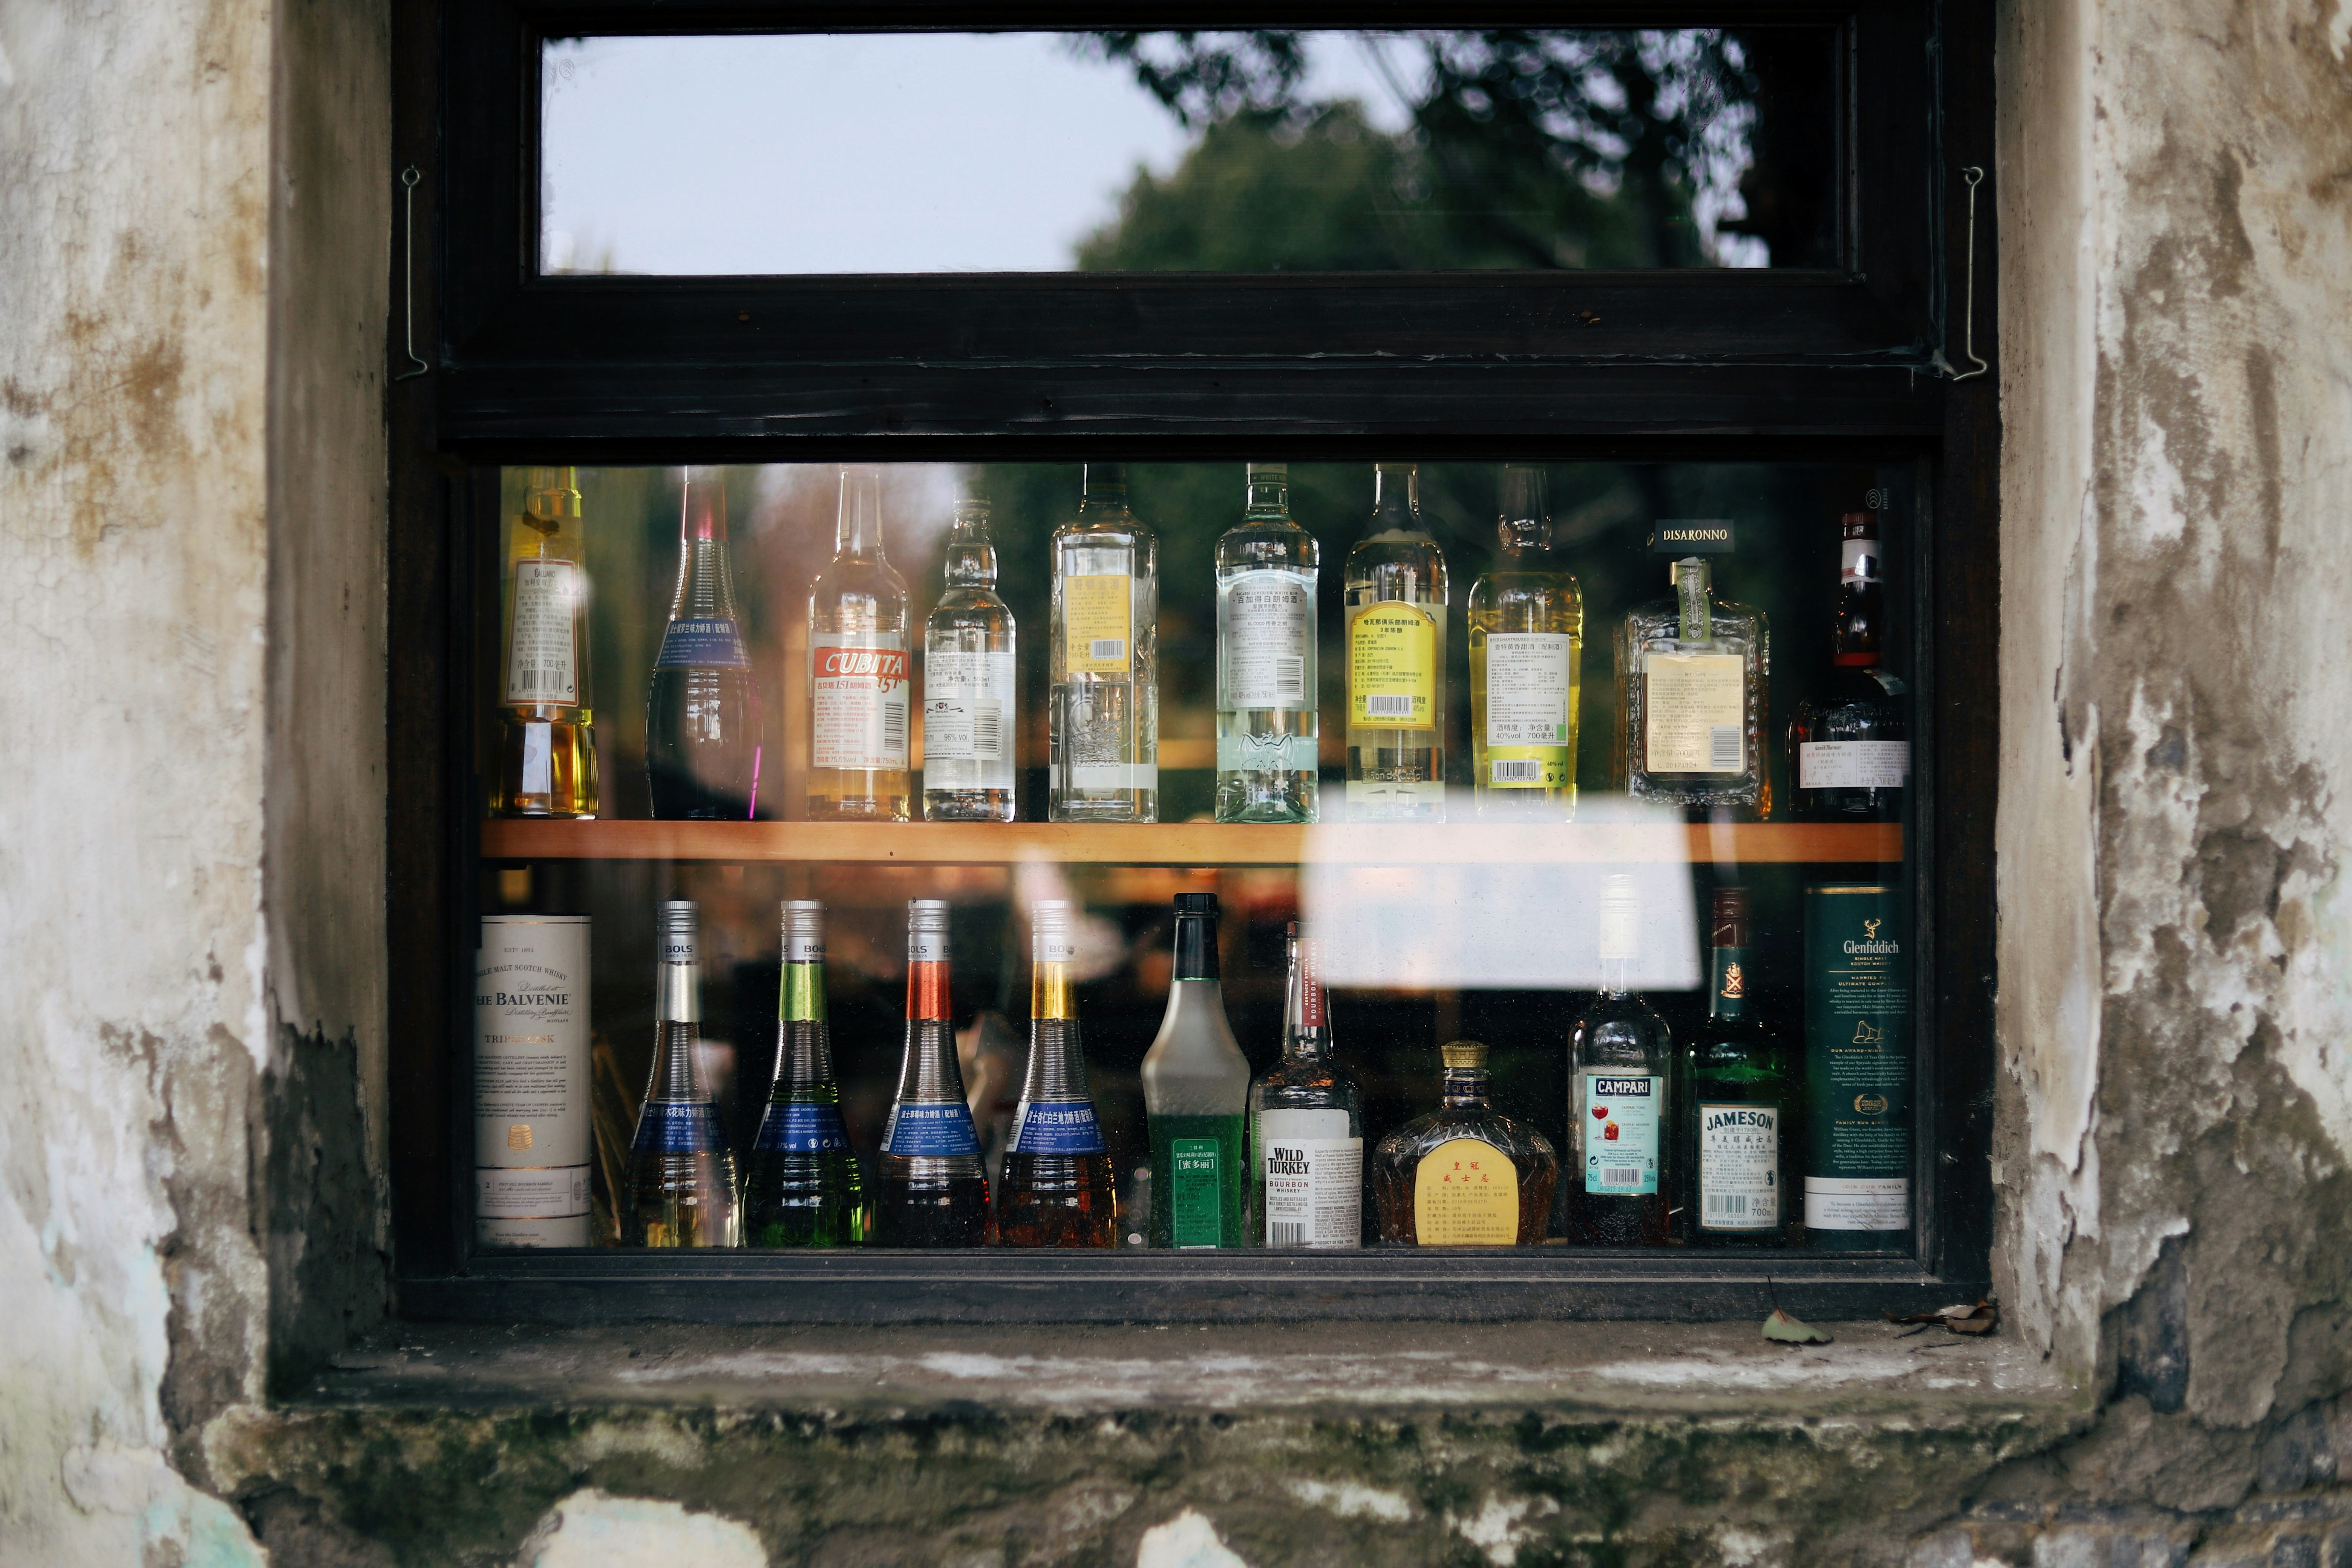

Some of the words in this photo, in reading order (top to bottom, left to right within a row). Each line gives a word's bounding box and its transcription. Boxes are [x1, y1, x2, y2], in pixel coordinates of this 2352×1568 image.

[1663, 529, 1727, 541] DISARONNO
[534, 568, 555, 577] GALLIANO
[1238, 596, 1297, 604] 百加得白朗姆酒
[1070, 643, 1090, 651] 净含量
[825, 652, 902, 675] CUBITA
[836, 680, 849, 689] 151
[1411, 695, 1426, 704] 酒精度
[1496, 724, 1522, 732] 酒精度：
[1528, 724, 1554, 732] 净含量：
[1844, 940, 1899, 954] Glenfiddich
[494, 965, 513, 973] MALT
[544, 968, 567, 982] WHISKY
[518, 981, 549, 992] Distilled
[496, 992, 568, 1006] BALVENIE
[485, 1035, 524, 1043] TRIPLE
[528, 1035, 554, 1043] CASK
[1598, 1080, 1648, 1093] CAMPARI
[1707, 1112, 1774, 1131] JAMESON
[1710, 1135, 1772, 1144] 尊美醇威士忌
[1274, 1147, 1303, 1161] WILD
[1268, 1158, 1311, 1175] TURKEY
[1453, 1161, 1479, 1170] 皇冠
[1443, 1173, 1489, 1183] 威士忌
[1752, 1197, 1776, 1207] 净含量
[1752, 1208, 1774, 1216] 700ml
